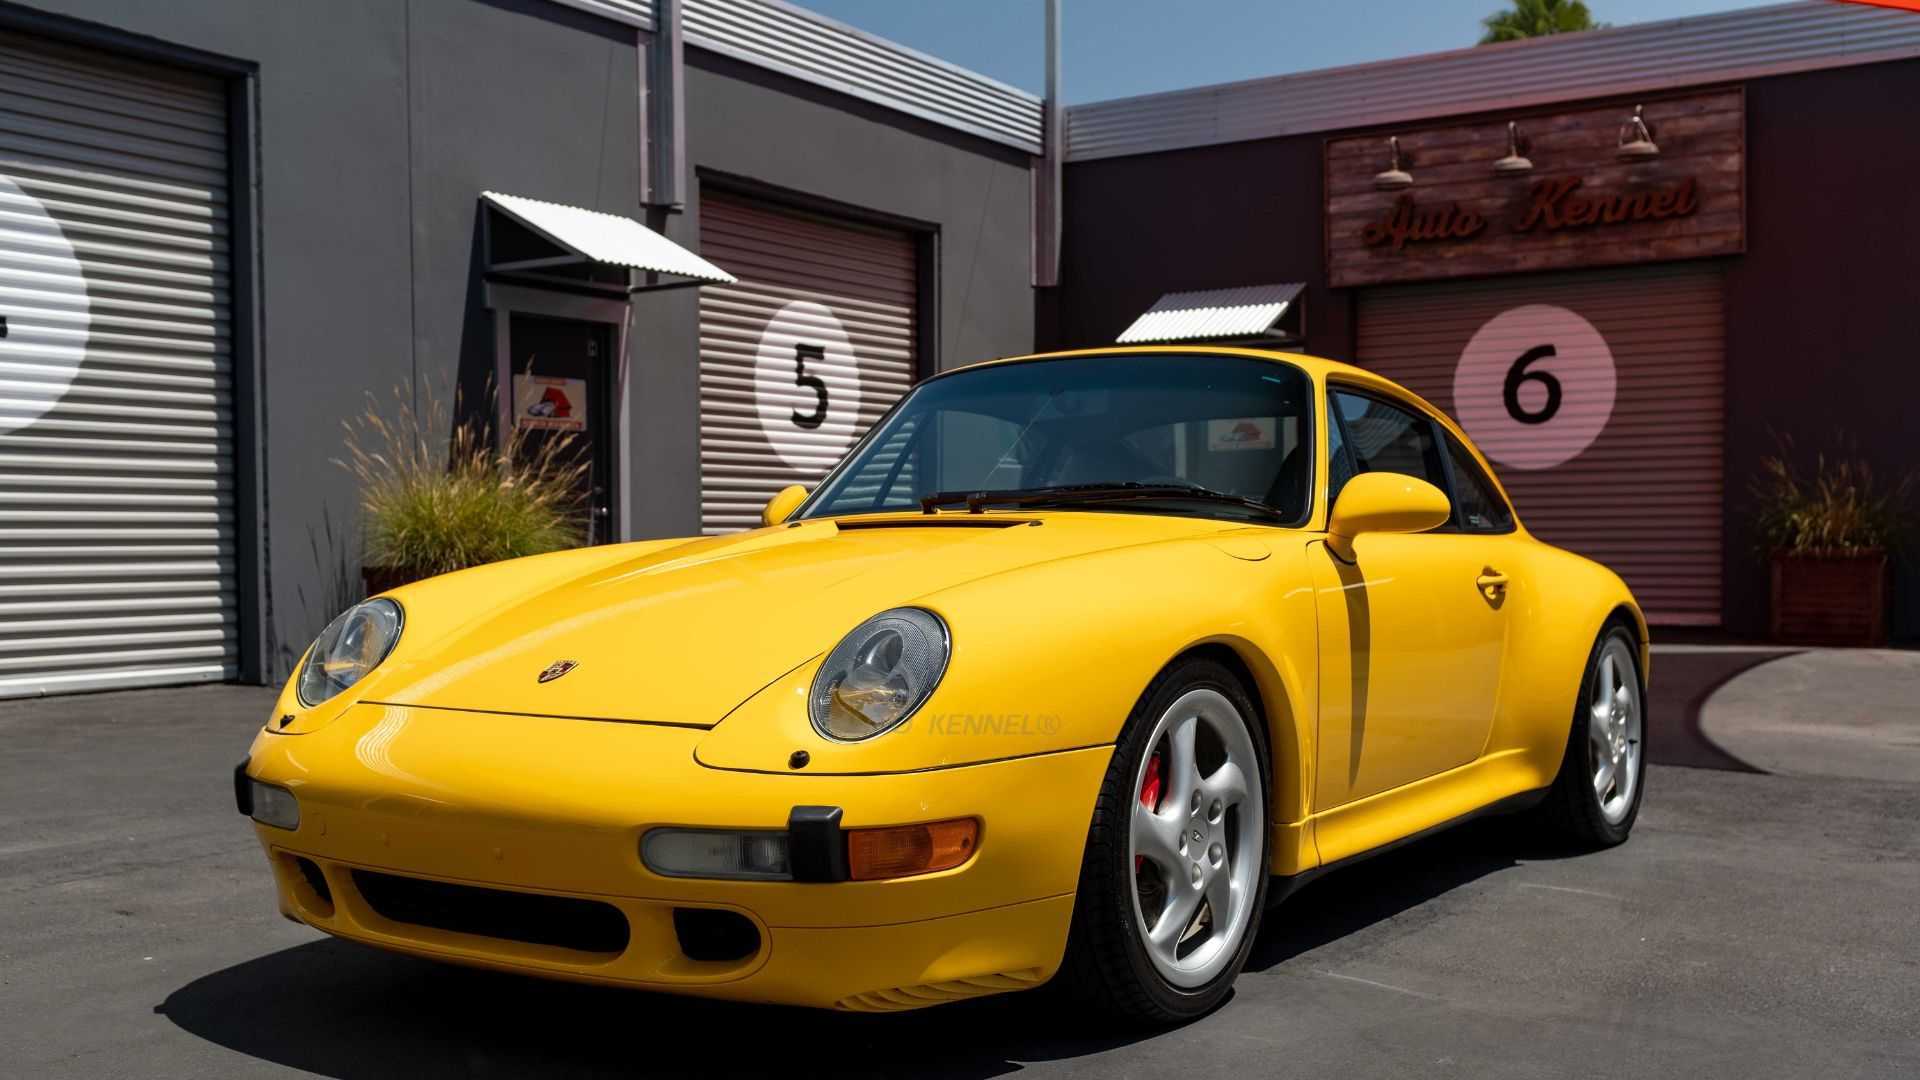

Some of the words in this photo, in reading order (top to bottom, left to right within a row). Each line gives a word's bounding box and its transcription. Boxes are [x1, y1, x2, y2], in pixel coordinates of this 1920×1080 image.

[1361, 195, 1488, 250] Auto
[1513, 175, 1698, 234] Kennel
[791, 343, 829, 430] 5
[1503, 343, 1562, 425] 6
